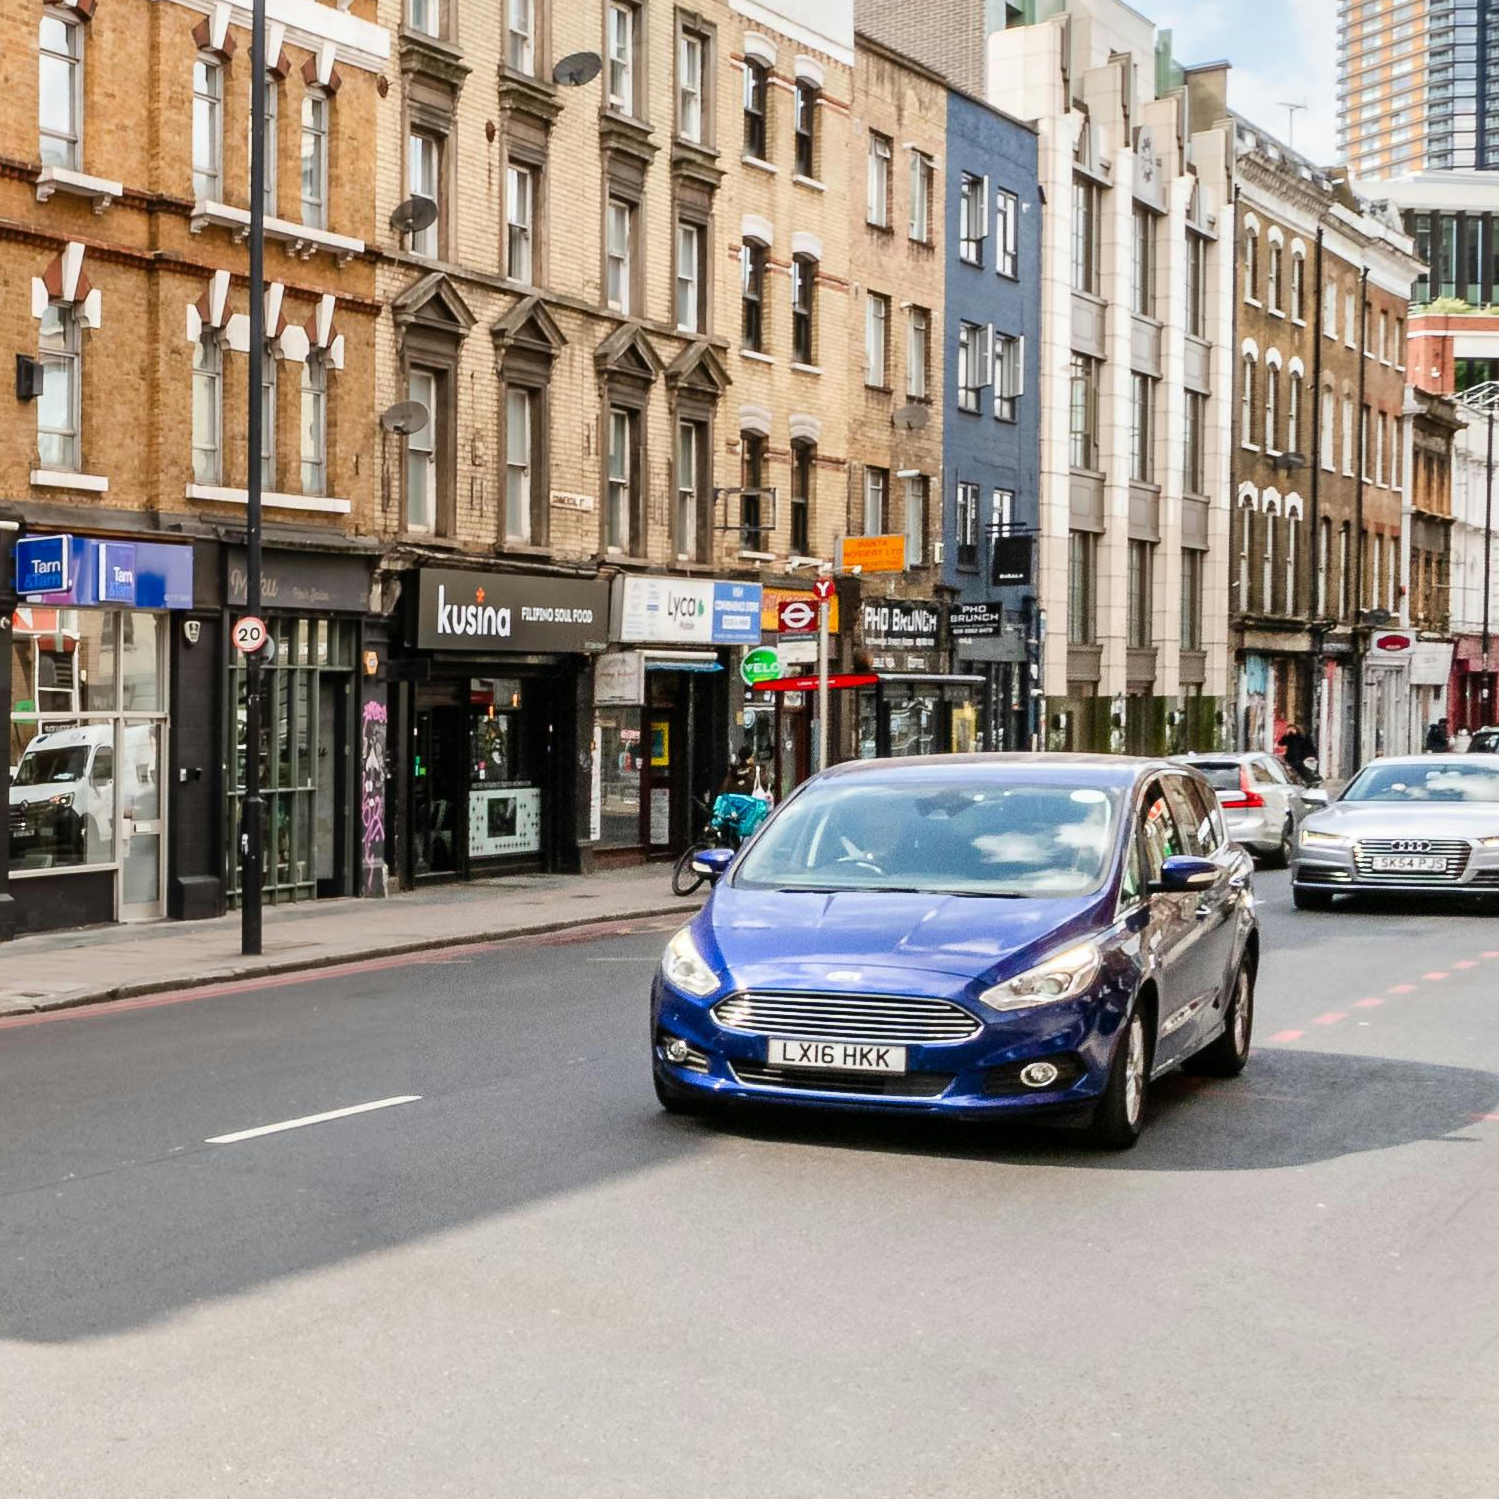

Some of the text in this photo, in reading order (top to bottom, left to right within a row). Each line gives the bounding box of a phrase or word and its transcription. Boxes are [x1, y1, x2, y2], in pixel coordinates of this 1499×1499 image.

[31, 559, 61, 574] Tarn
[113, 566, 133, 583] Tarn
[230, 569, 279, 598] Mku
[816, 581, 830, 598] Y
[437, 584, 511, 637] kusina
[667, 591, 697, 622] Lyca
[962, 605, 987, 613] PHO
[573, 609, 593, 624] FOOD
[865, 607, 889, 630] PHO
[892, 608, 937, 632] BRUNCH
[950, 613, 999, 623] BRUNCH
[238, 627, 261, 642] 20
[782, 1042, 890, 1069] LX16 HKK
